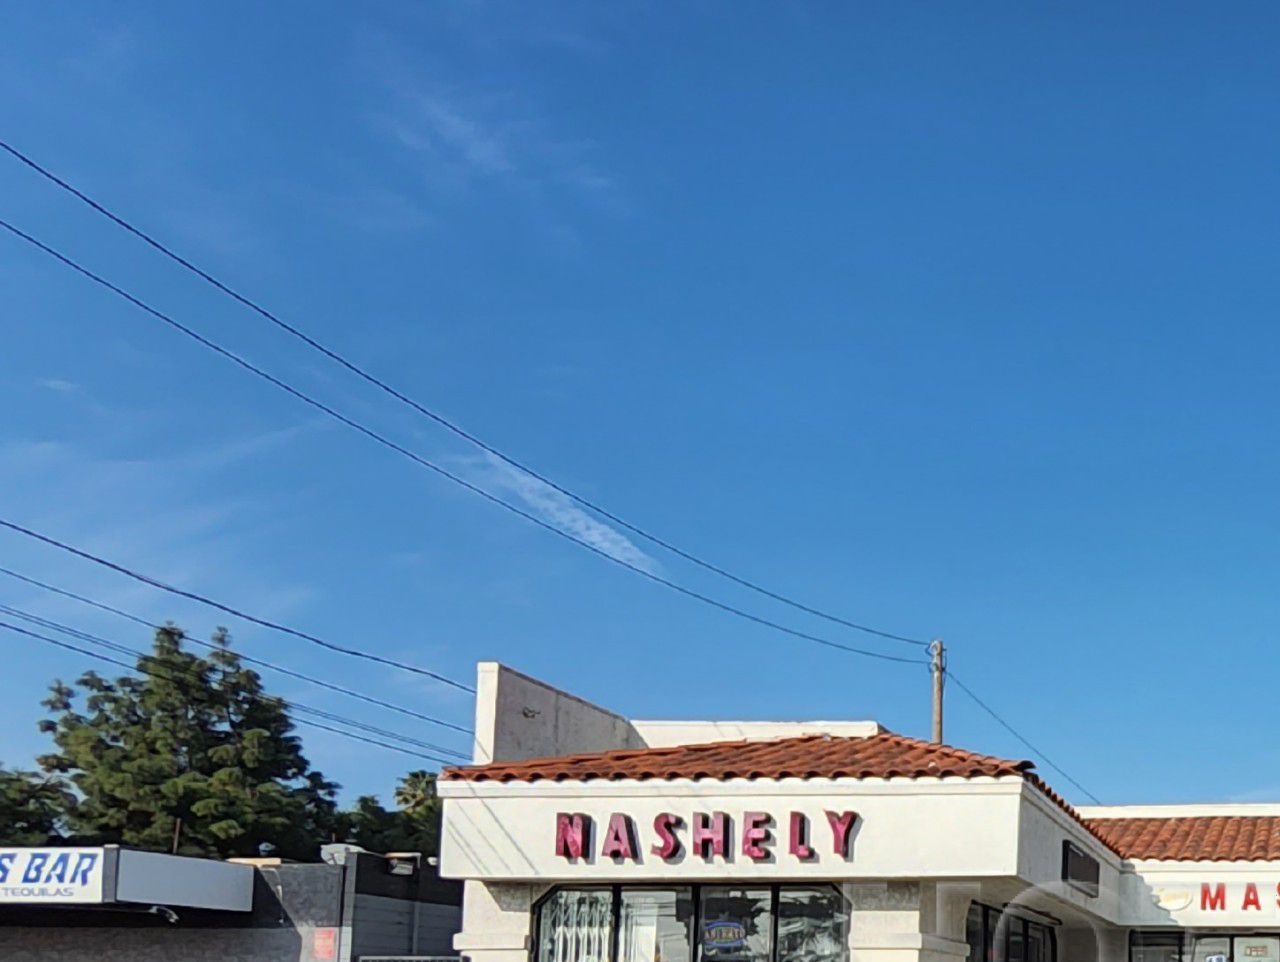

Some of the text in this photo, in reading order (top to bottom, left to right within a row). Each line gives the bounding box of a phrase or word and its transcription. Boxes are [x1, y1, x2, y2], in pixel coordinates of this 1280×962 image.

[555, 809, 864, 864] NASHELY
[22, 853, 98, 886] BAR
[2, 887, 74, 897] TEQUILAS
